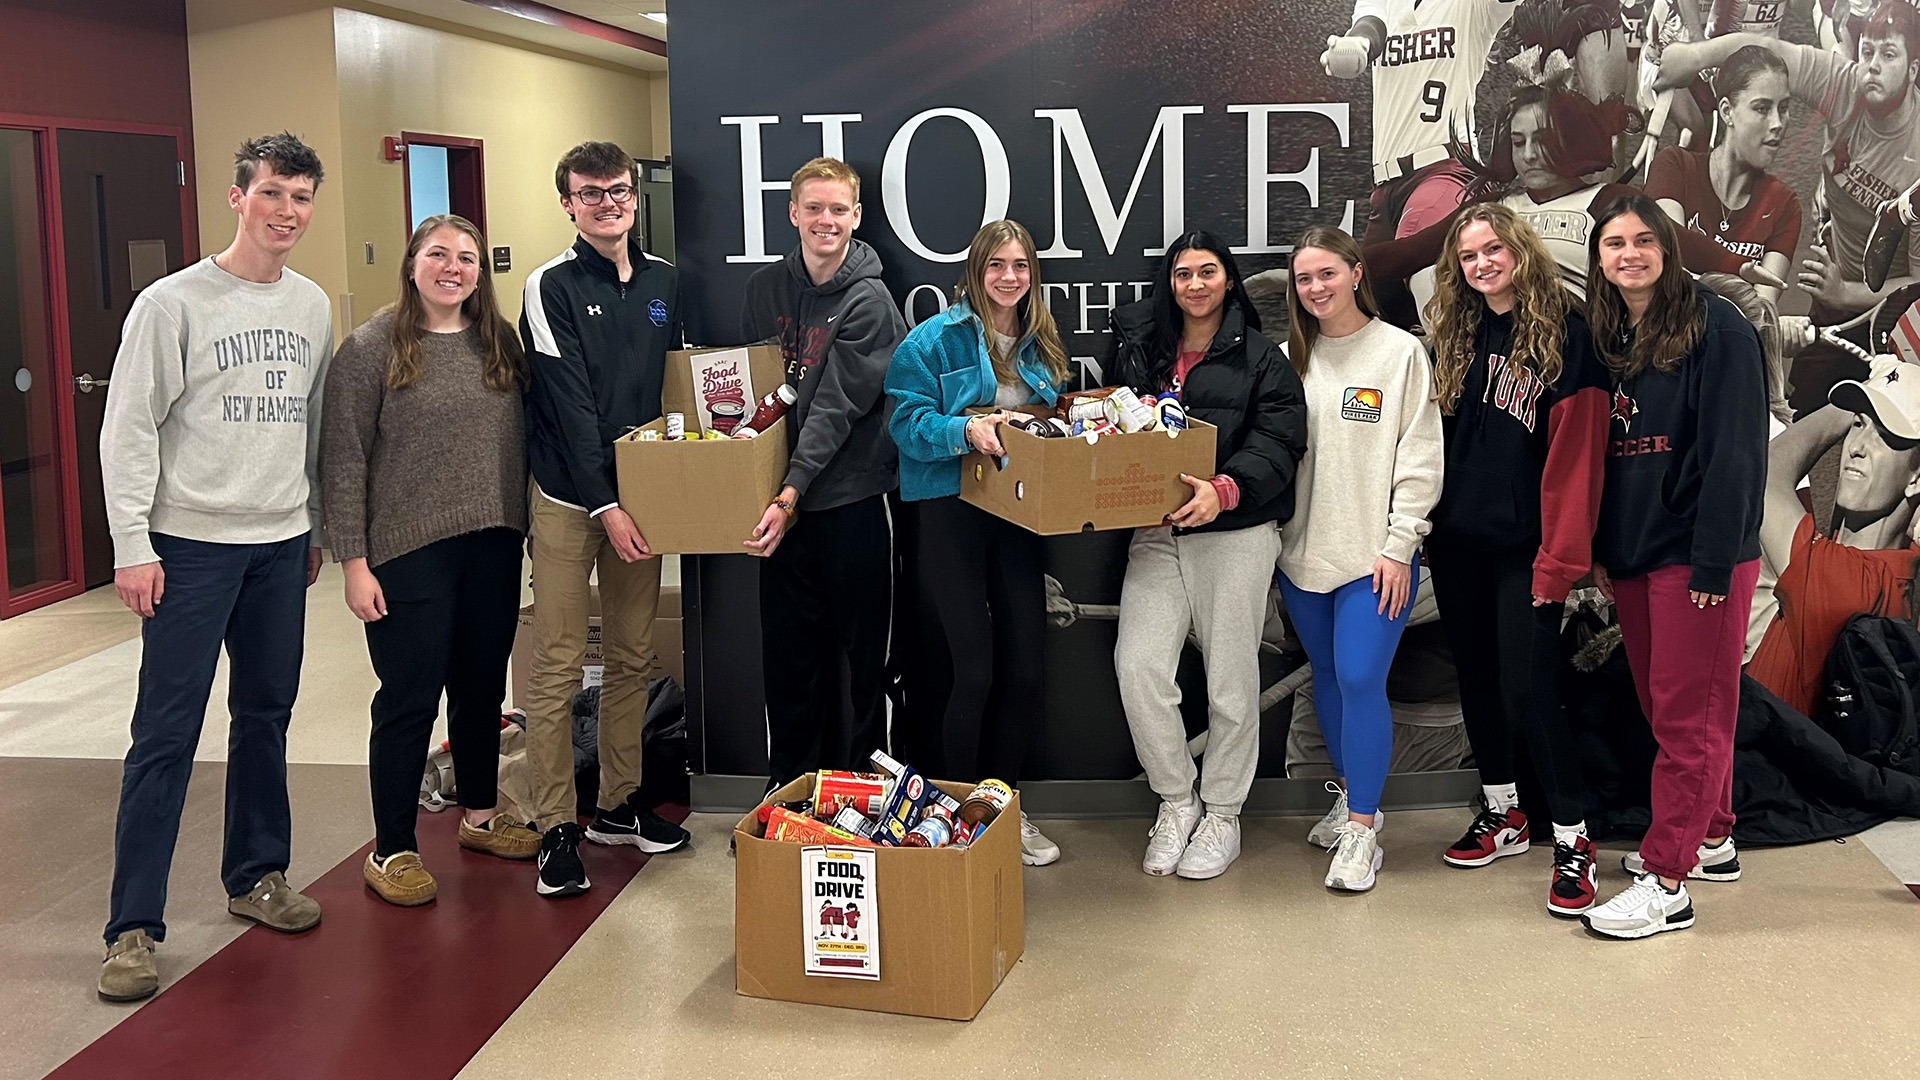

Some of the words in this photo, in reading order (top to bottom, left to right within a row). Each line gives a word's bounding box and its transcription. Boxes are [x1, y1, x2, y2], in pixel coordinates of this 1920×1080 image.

[1756, 3, 1779, 22] 64
[1374, 26, 1456, 67] ISHER
[1420, 80, 1447, 123] 9
[720, 102, 1354, 264] HOME
[1841, 177, 1882, 210] TENN
[265, 370, 287, 389] OF
[702, 361, 740, 381] Food
[702, 378, 744, 395] Drive
[1482, 353, 1545, 434] YORK
[222, 395, 253, 422] NEW
[256, 396, 307, 423] HAMPSH
[1608, 435, 1672, 457] CCER
[817, 861, 861, 879] FOOD
[814, 881, 865, 899] DRIVE
